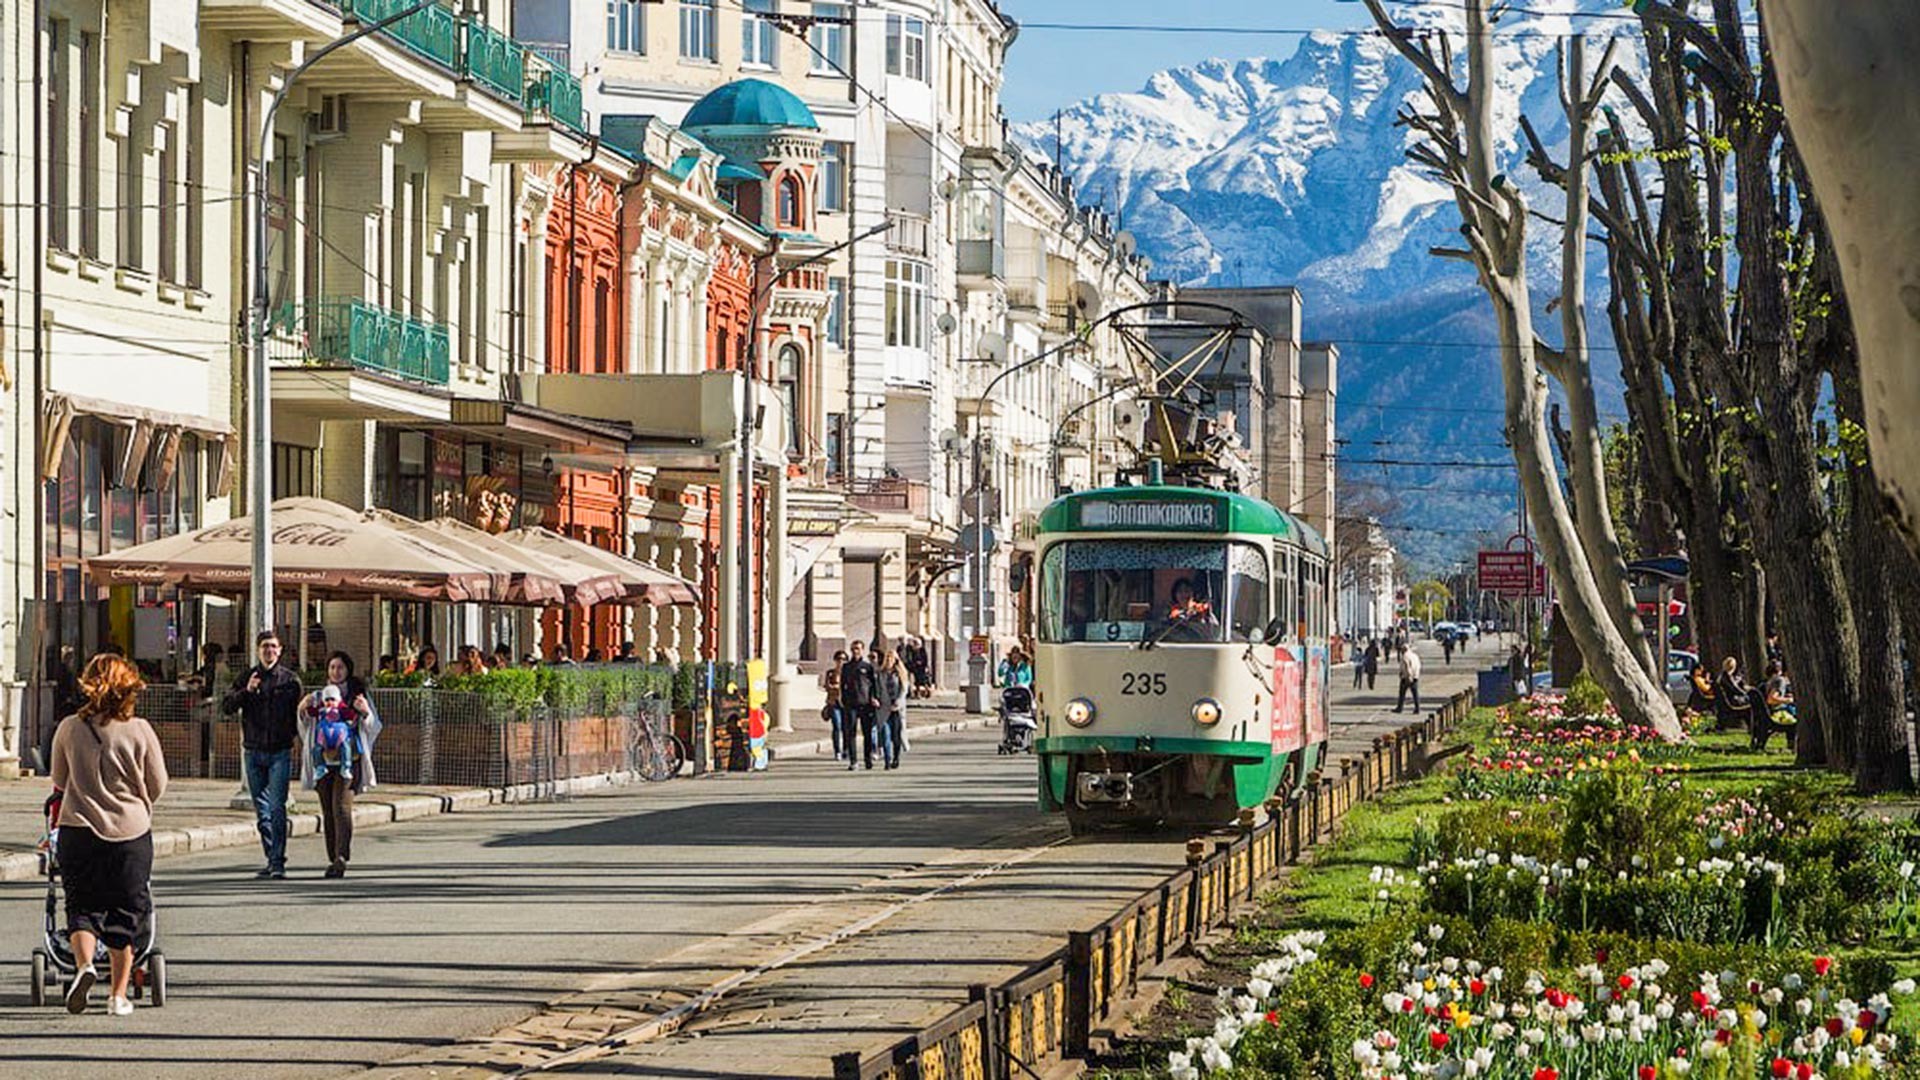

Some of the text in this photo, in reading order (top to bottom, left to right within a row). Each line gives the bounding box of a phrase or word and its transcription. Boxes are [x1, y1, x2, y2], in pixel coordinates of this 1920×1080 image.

[1108, 503, 1213, 526] ВЛАДИКАВКАЗ
[193, 522, 352, 548] CocaCola
[206, 569, 327, 579] открой частью!
[1107, 622, 1121, 641] 9
[1121, 672, 1168, 696] 235
